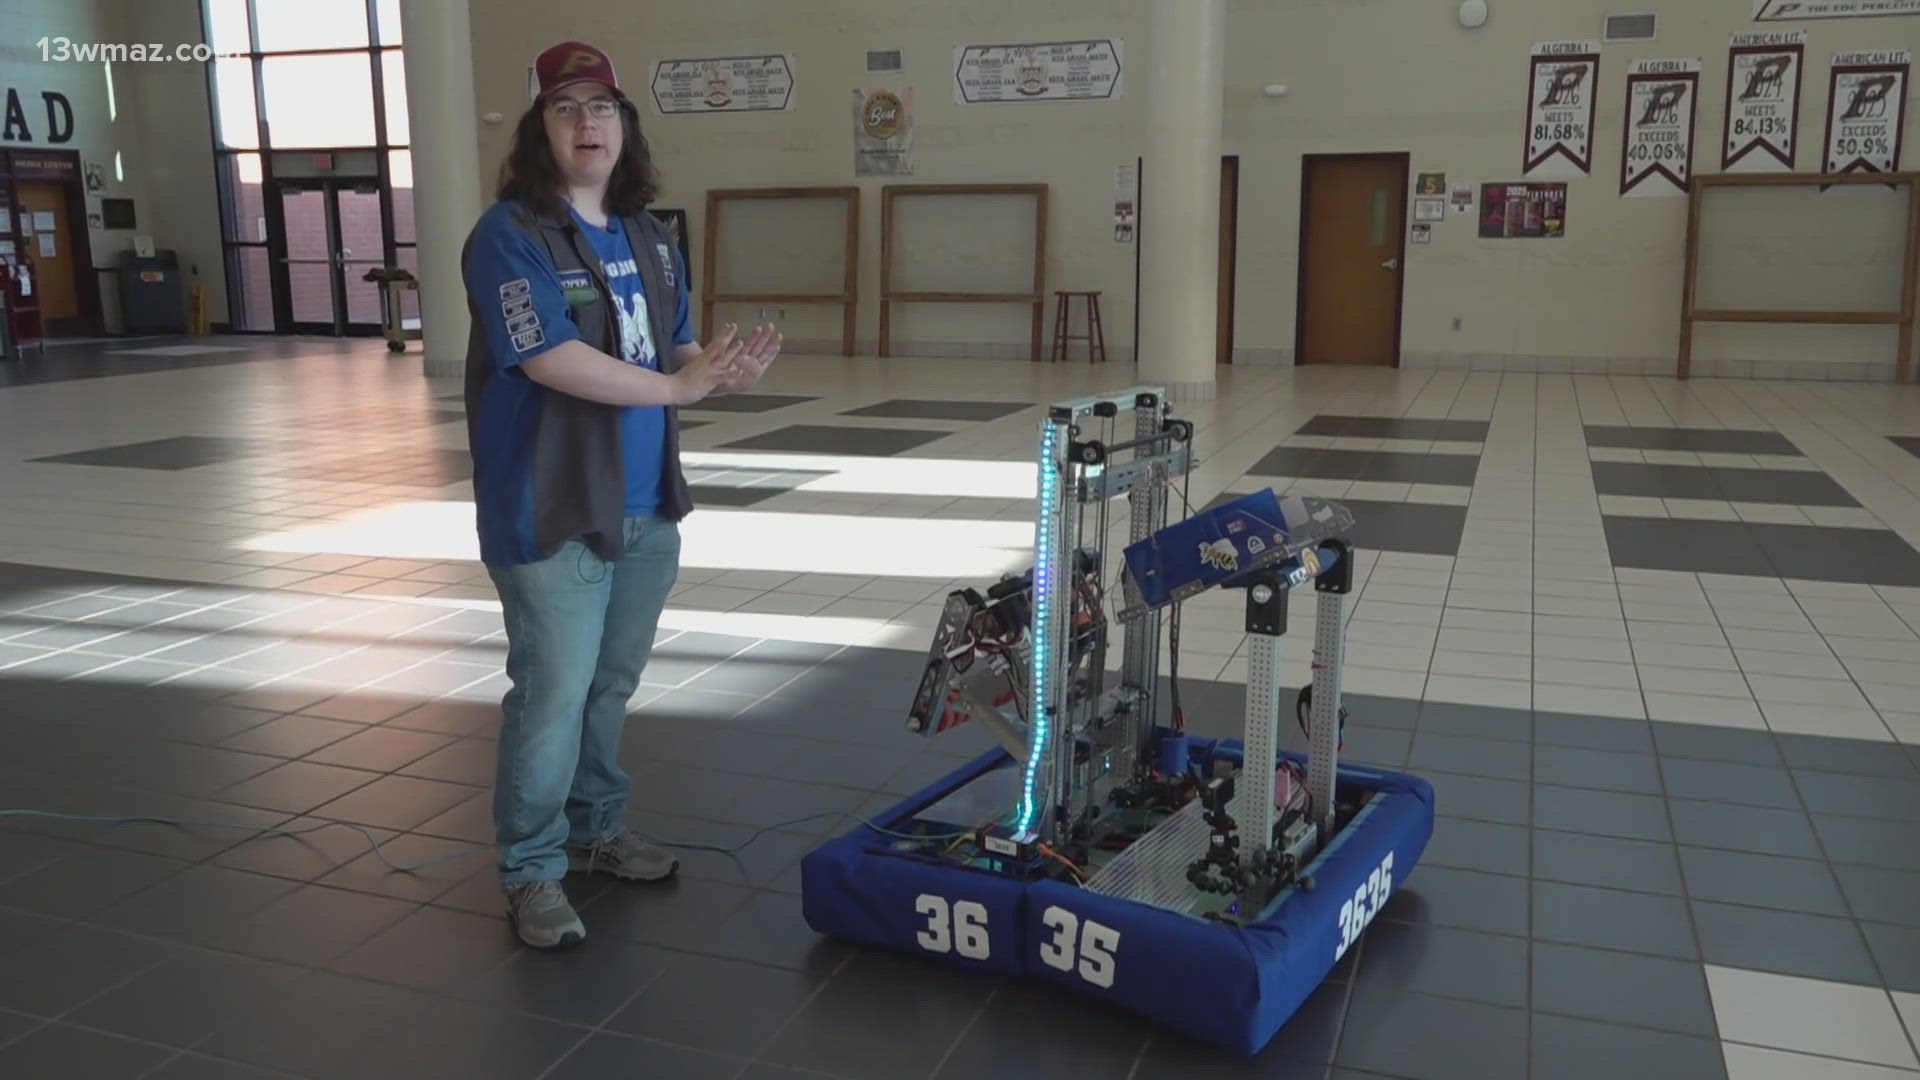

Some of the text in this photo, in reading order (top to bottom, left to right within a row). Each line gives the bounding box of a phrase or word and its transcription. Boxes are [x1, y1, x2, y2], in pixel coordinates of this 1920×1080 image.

[1732, 32, 1782, 45] AMERICAN
[1541, 44, 1582, 53] ALGEBRA
[1835, 53, 1886, 65] AMERICAN
[1638, 62, 1680, 73] ALGEBRA
[1544, 112, 1574, 122] MEETS
[1744, 104, 1776, 117] MEETS
[1534, 124, 1585, 141] 81.68%
[1734, 117, 1787, 135] 84.13%
[1841, 125, 1887, 137] EXCEEDS
[1638, 131, 1680, 142] EXCEEDS
[1629, 143, 1686, 161] 40.06%
[1836, 138, 1888, 156] 50.9%
[1335, 850, 1394, 962] 3635
[915, 893, 990, 961] 36
[1040, 905, 1121, 989] 35
